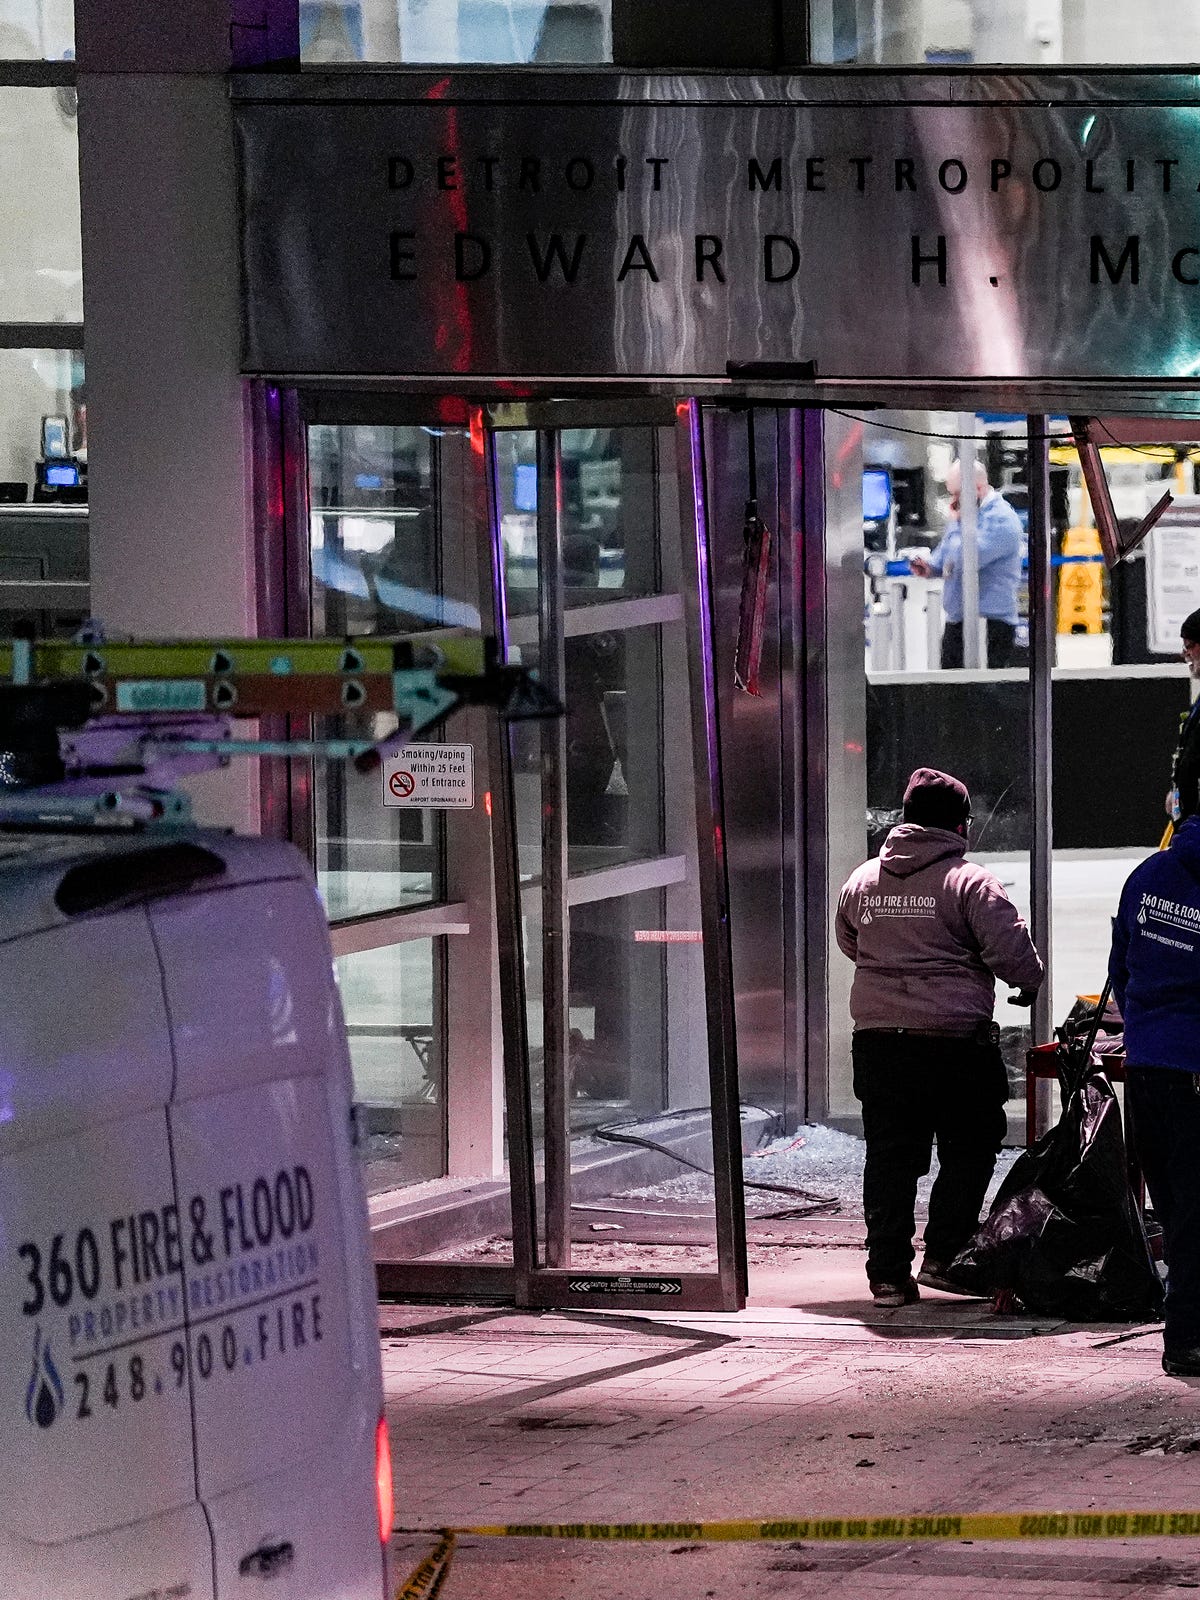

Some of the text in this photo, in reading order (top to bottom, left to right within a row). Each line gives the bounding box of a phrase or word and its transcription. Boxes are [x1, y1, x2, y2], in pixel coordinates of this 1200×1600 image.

[387, 157, 669, 192] DETROIT
[388, 231, 801, 284] EDWARD
[910, 235, 999, 288] H.
[401, 750, 465, 761] Smoking/Vaping
[410, 763, 466, 773] Within 25 Feet
[421, 777, 466, 787] of Entrance
[862, 895, 937, 909] 360 FIRE & FLOOD
[1140, 892, 1158, 908] 360
[1157, 898, 1176, 914] FIRE
[1174, 903, 1181, 916] &
[18, 1164, 314, 1317] 360 FIRE & FLOOD
[68, 1243, 320, 1346] PROPERTY RESTORATION
